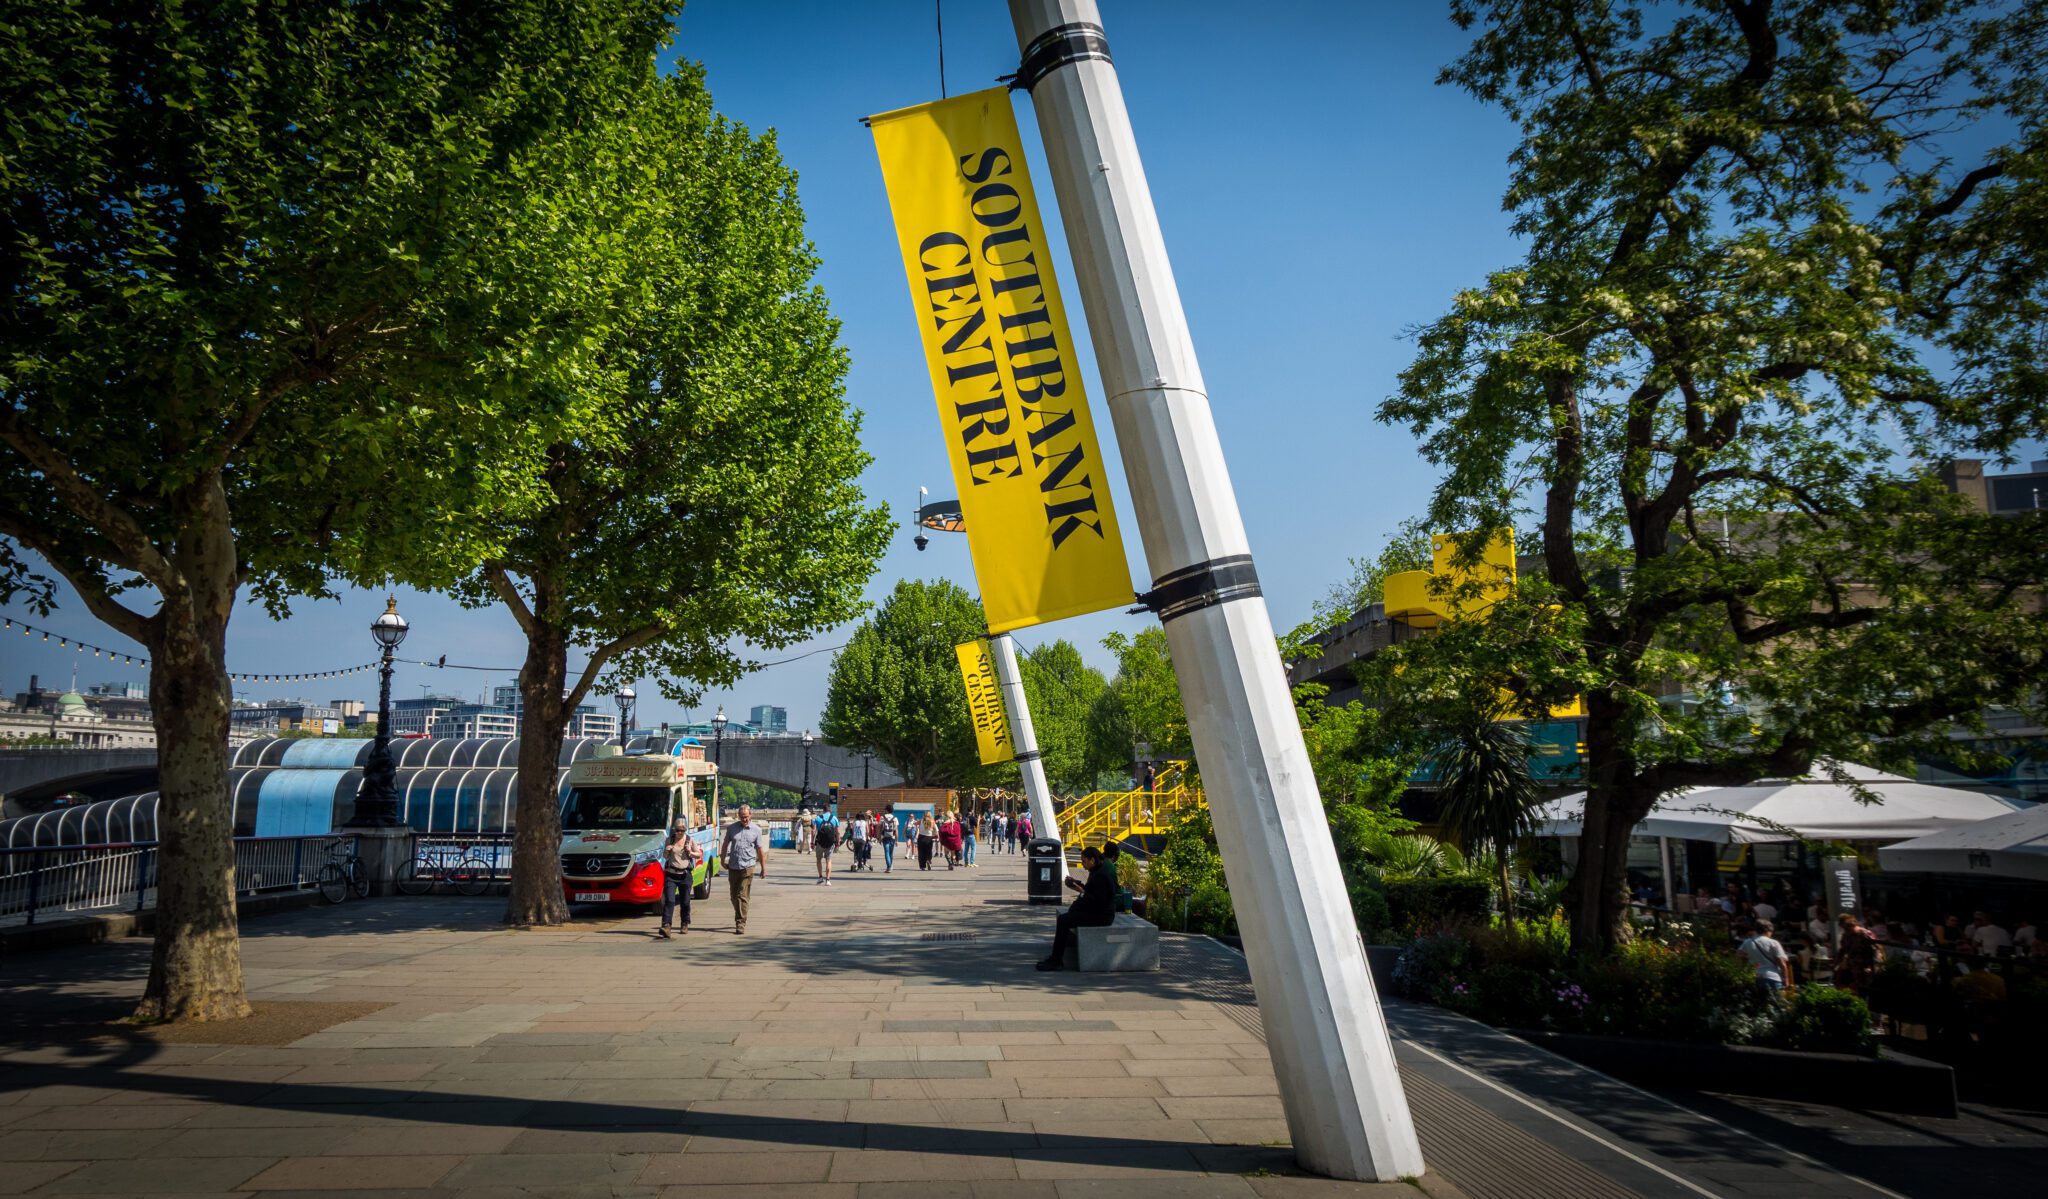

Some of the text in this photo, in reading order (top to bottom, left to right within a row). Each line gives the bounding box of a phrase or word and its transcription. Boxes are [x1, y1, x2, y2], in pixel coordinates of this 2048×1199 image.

[919, 231, 1023, 486] CENTRE
[960, 147, 1104, 551] SOUTHBANK
[967, 673, 990, 733] CENTRE
[976, 653, 1008, 747] SOUTHBANK
[584, 766, 659, 777] SUPER SOFT ICE
[1835, 869, 1856, 908] giraffe
